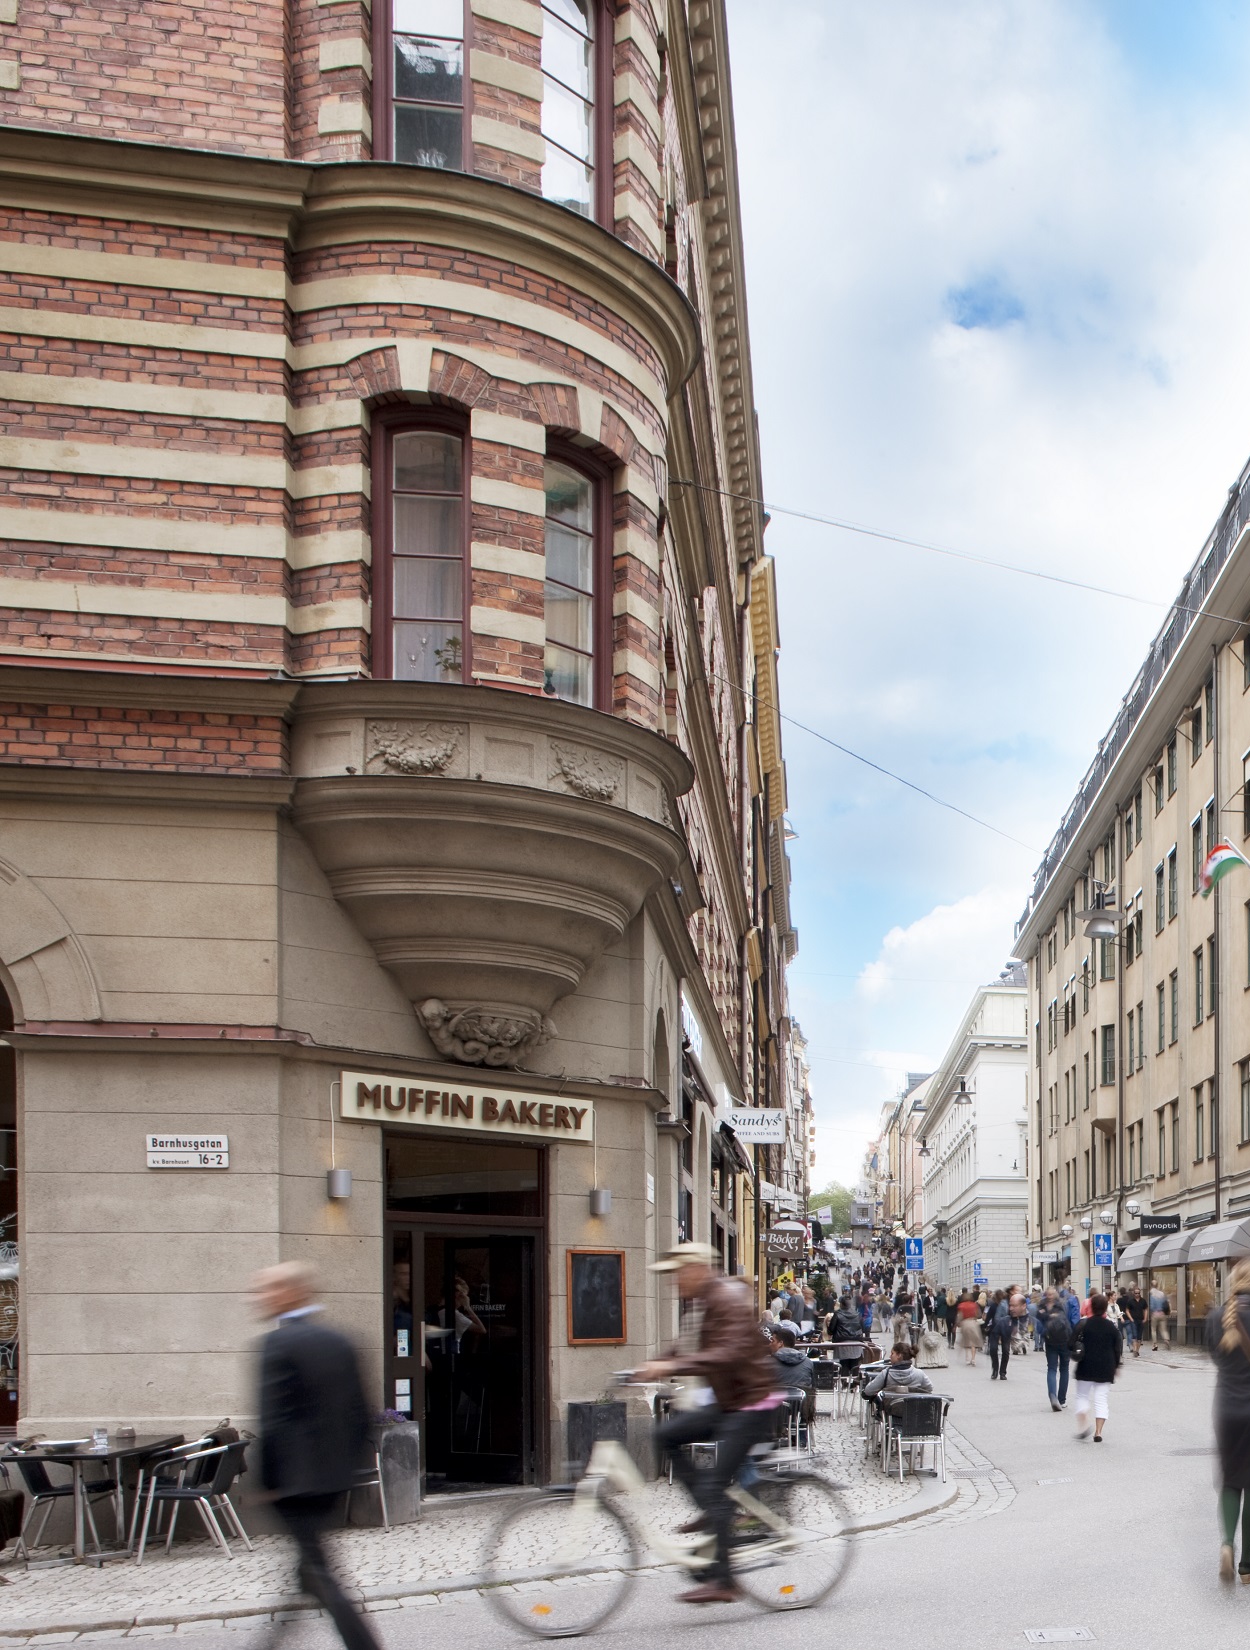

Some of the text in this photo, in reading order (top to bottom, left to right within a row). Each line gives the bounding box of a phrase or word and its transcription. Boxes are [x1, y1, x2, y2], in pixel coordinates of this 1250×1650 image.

[357, 1082, 587, 1129] MUFFIN BAKERY
[730, 1114, 779, 1130] Sandys
[151, 1138, 222, 1150] Barnhusgatan
[198, 1154, 223, 1165] 16-2
[1143, 1222, 1178, 1231] synoptik
[768, 1233, 800, 1250] Böcker
